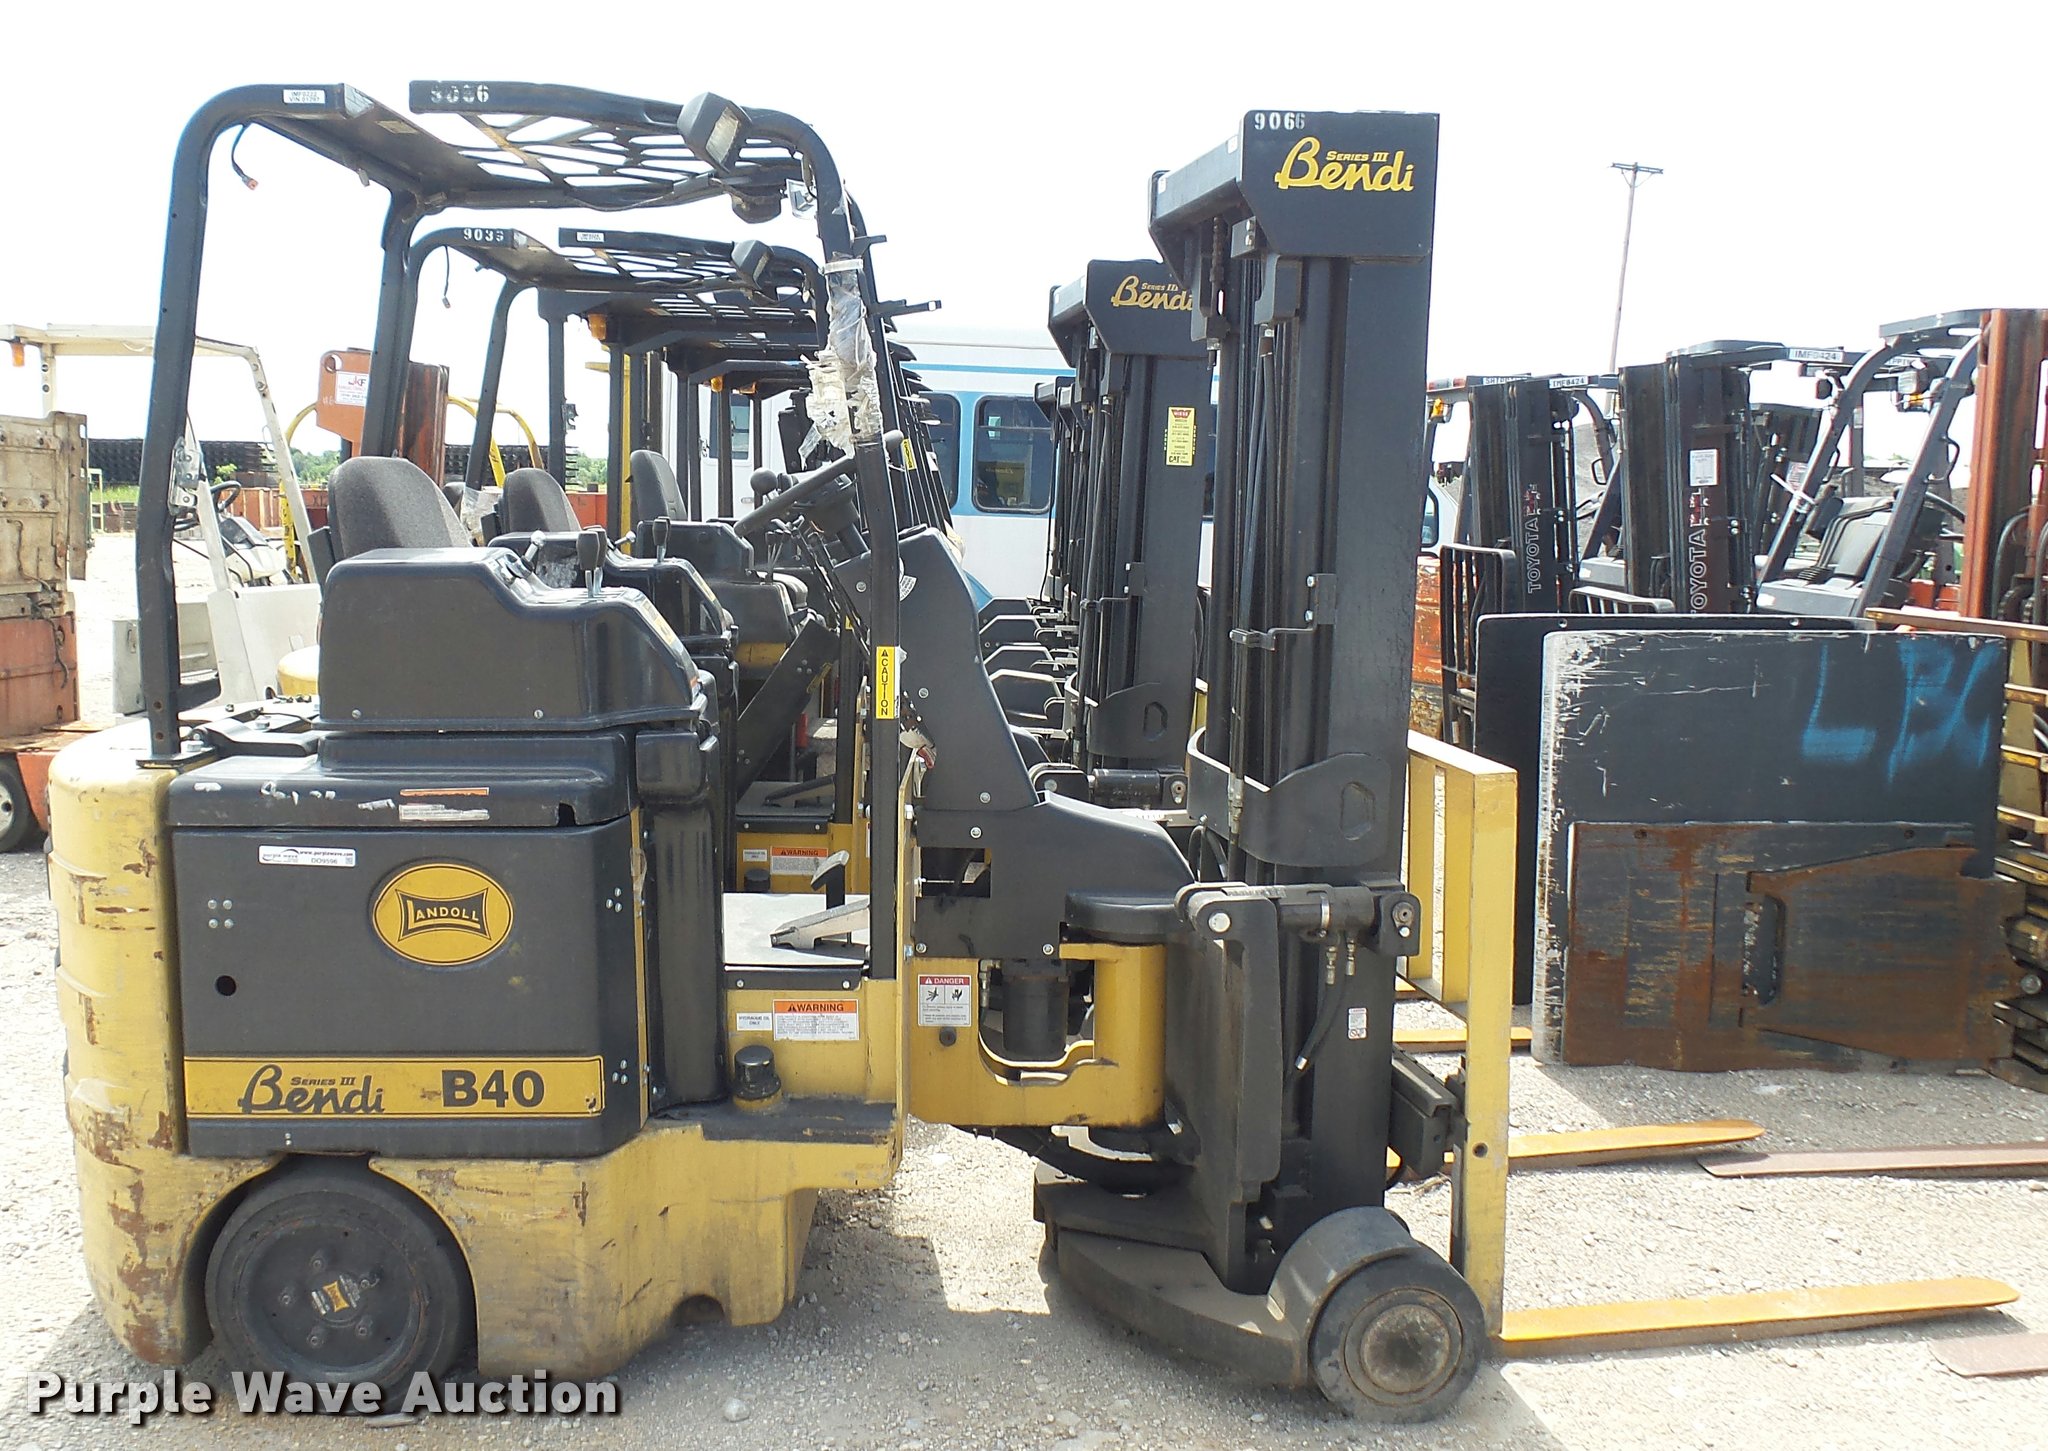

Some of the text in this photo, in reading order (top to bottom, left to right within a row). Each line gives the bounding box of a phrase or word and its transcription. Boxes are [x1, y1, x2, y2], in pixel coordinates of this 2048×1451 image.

[1254, 112, 1306, 131] 9066
[1274, 136, 1415, 192] Bendi
[1326, 150, 1369, 162] SERIES
[1110, 275, 1193, 311] Bendi
[1525, 517, 1542, 594] TOYOTA
[1688, 528, 1708, 614] OYOTA
[881, 658, 889, 716] CAUTION
[406, 899, 481, 930] LANDOLL
[934, 977, 964, 985] DANGER
[797, 1003, 844, 1013] WARNING
[237, 1064, 385, 1115] Bendi
[290, 1076, 336, 1087] SERIES
[441, 1069, 545, 1108] B40
